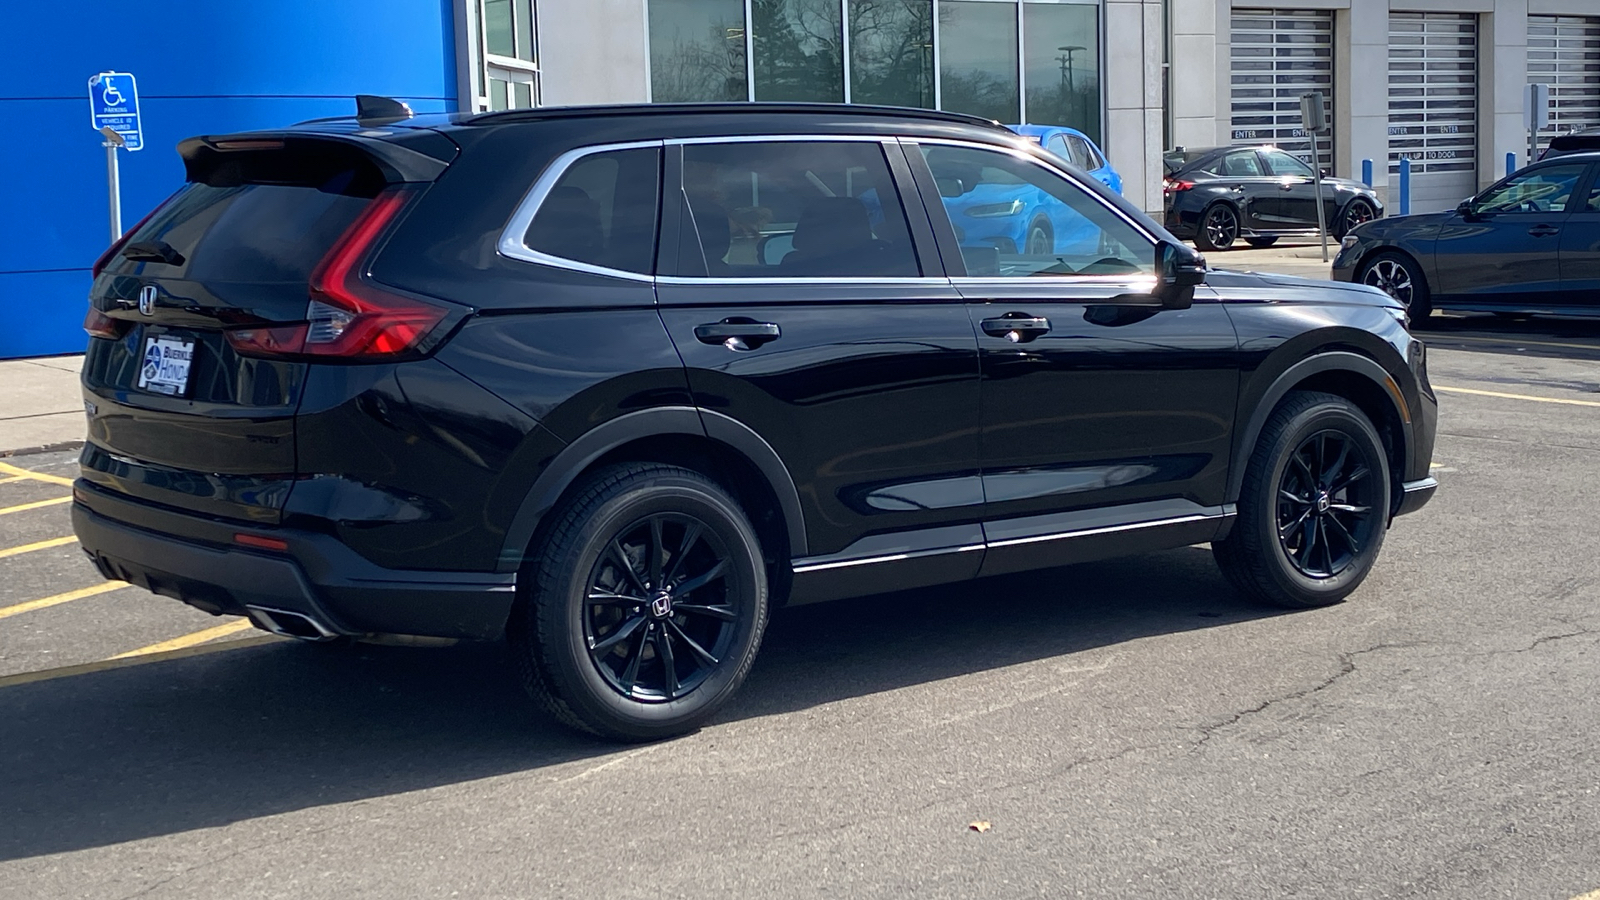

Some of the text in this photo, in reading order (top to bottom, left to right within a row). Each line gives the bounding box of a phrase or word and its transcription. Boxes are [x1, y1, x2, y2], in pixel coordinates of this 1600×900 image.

[1292, 129, 1311, 137] ENTE
[1388, 127, 1408, 135] ENTER
[1440, 125, 1459, 133] ENTER
[1235, 130, 1256, 138] ENTER
